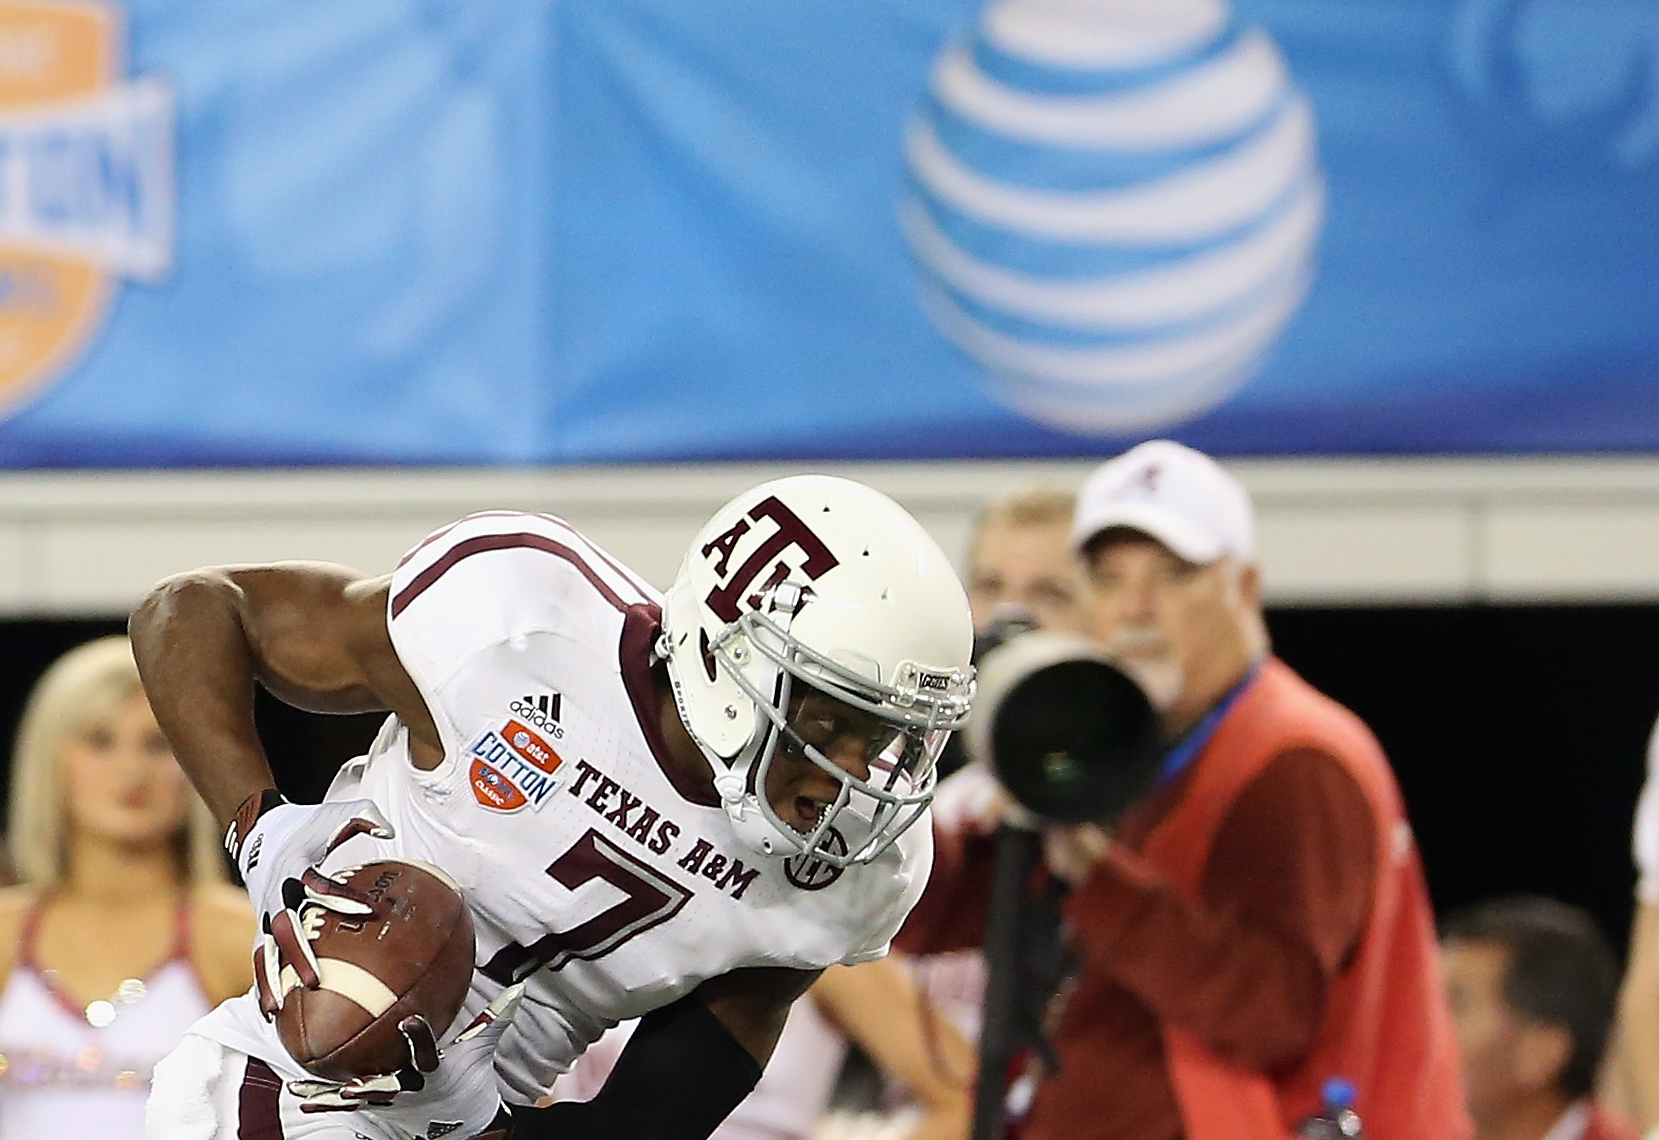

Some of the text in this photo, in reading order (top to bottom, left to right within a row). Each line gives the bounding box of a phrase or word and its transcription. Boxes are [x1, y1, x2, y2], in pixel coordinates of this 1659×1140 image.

[471, 730, 557, 806] COTTON
[509, 700, 566, 740] adidas
[568, 758, 681, 856] TEXAS
[676, 836, 762, 901] A&M
[474, 827, 695, 988] 7
